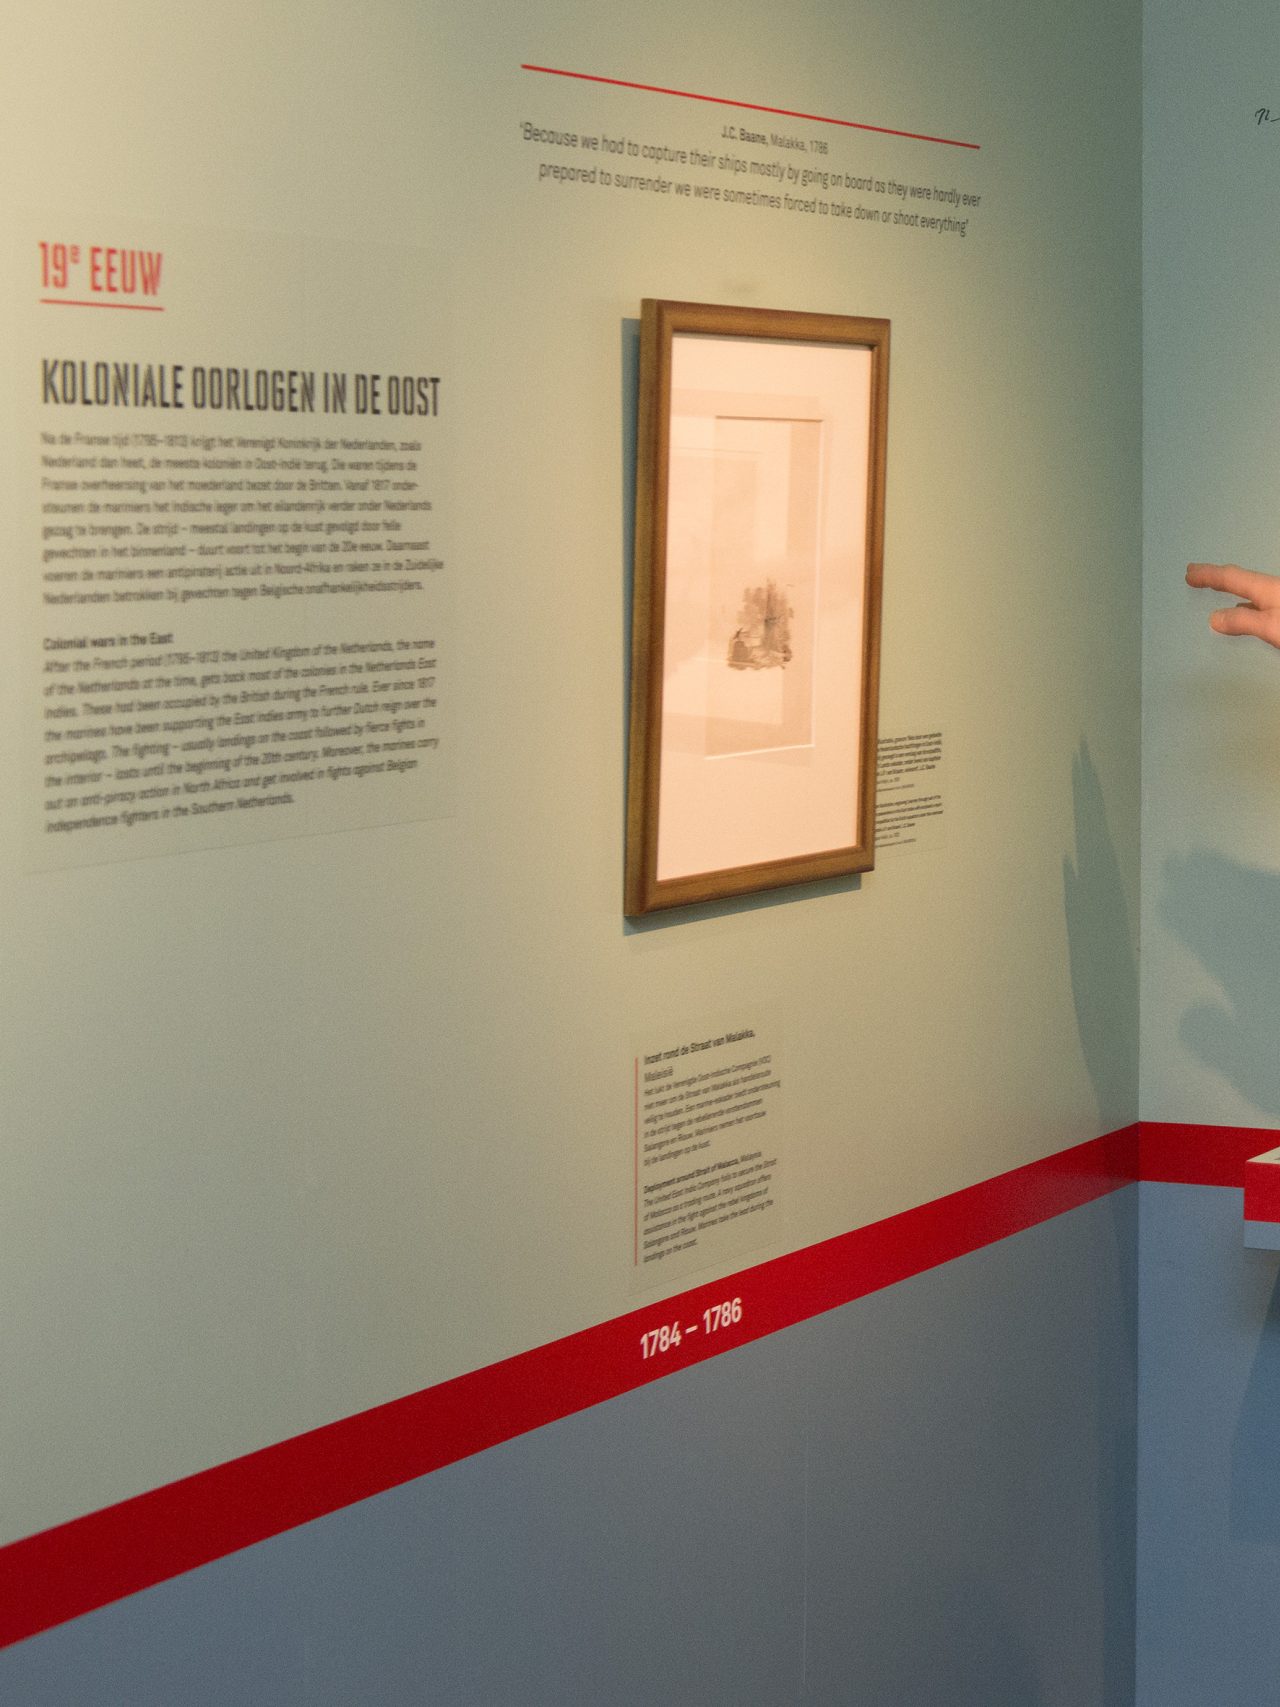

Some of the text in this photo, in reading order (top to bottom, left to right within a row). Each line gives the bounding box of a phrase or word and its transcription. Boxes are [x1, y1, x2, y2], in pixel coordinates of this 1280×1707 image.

[581, 136, 598, 150] we
[601, 135, 624, 154] had
[627, 139, 639, 156] to
[642, 141, 686, 168] capture
[690, 148, 715, 167] their
[718, 152, 747, 175] ships
[750, 157, 784, 180] mostly
[787, 163, 799, 183] by
[801, 166, 828, 188] going
[830, 172, 842, 186] on
[845, 171, 872, 191] board
[874, 179, 885, 192] as
[888, 177, 907, 200] they
[910, 184, 931, 199] were
[933, 184, 960, 208] hardly
[962, 192, 980, 206] ever
[810, 139, 828, 153] 1786
[538, 163, 596, 190] prepared
[599, 171, 611, 188] to
[615, 173, 671, 195] surrender
[675, 184, 690, 198] we
[694, 186, 720, 201] were
[722, 187, 780, 208] sometimes
[783, 195, 815, 213] forced
[817, 199, 828, 214] to
[831, 200, 851, 218] take
[854, 203, 879, 222] down
[881, 210, 891, 223] or
[893, 208, 918, 227] shoot
[90, 246, 163, 296] EEUW
[42, 359, 441, 417] KOLONIALE OORLOGEN IN DE OOST
[640, 1321, 681, 1359] 1784
[703, 1297, 743, 1335] 1786
